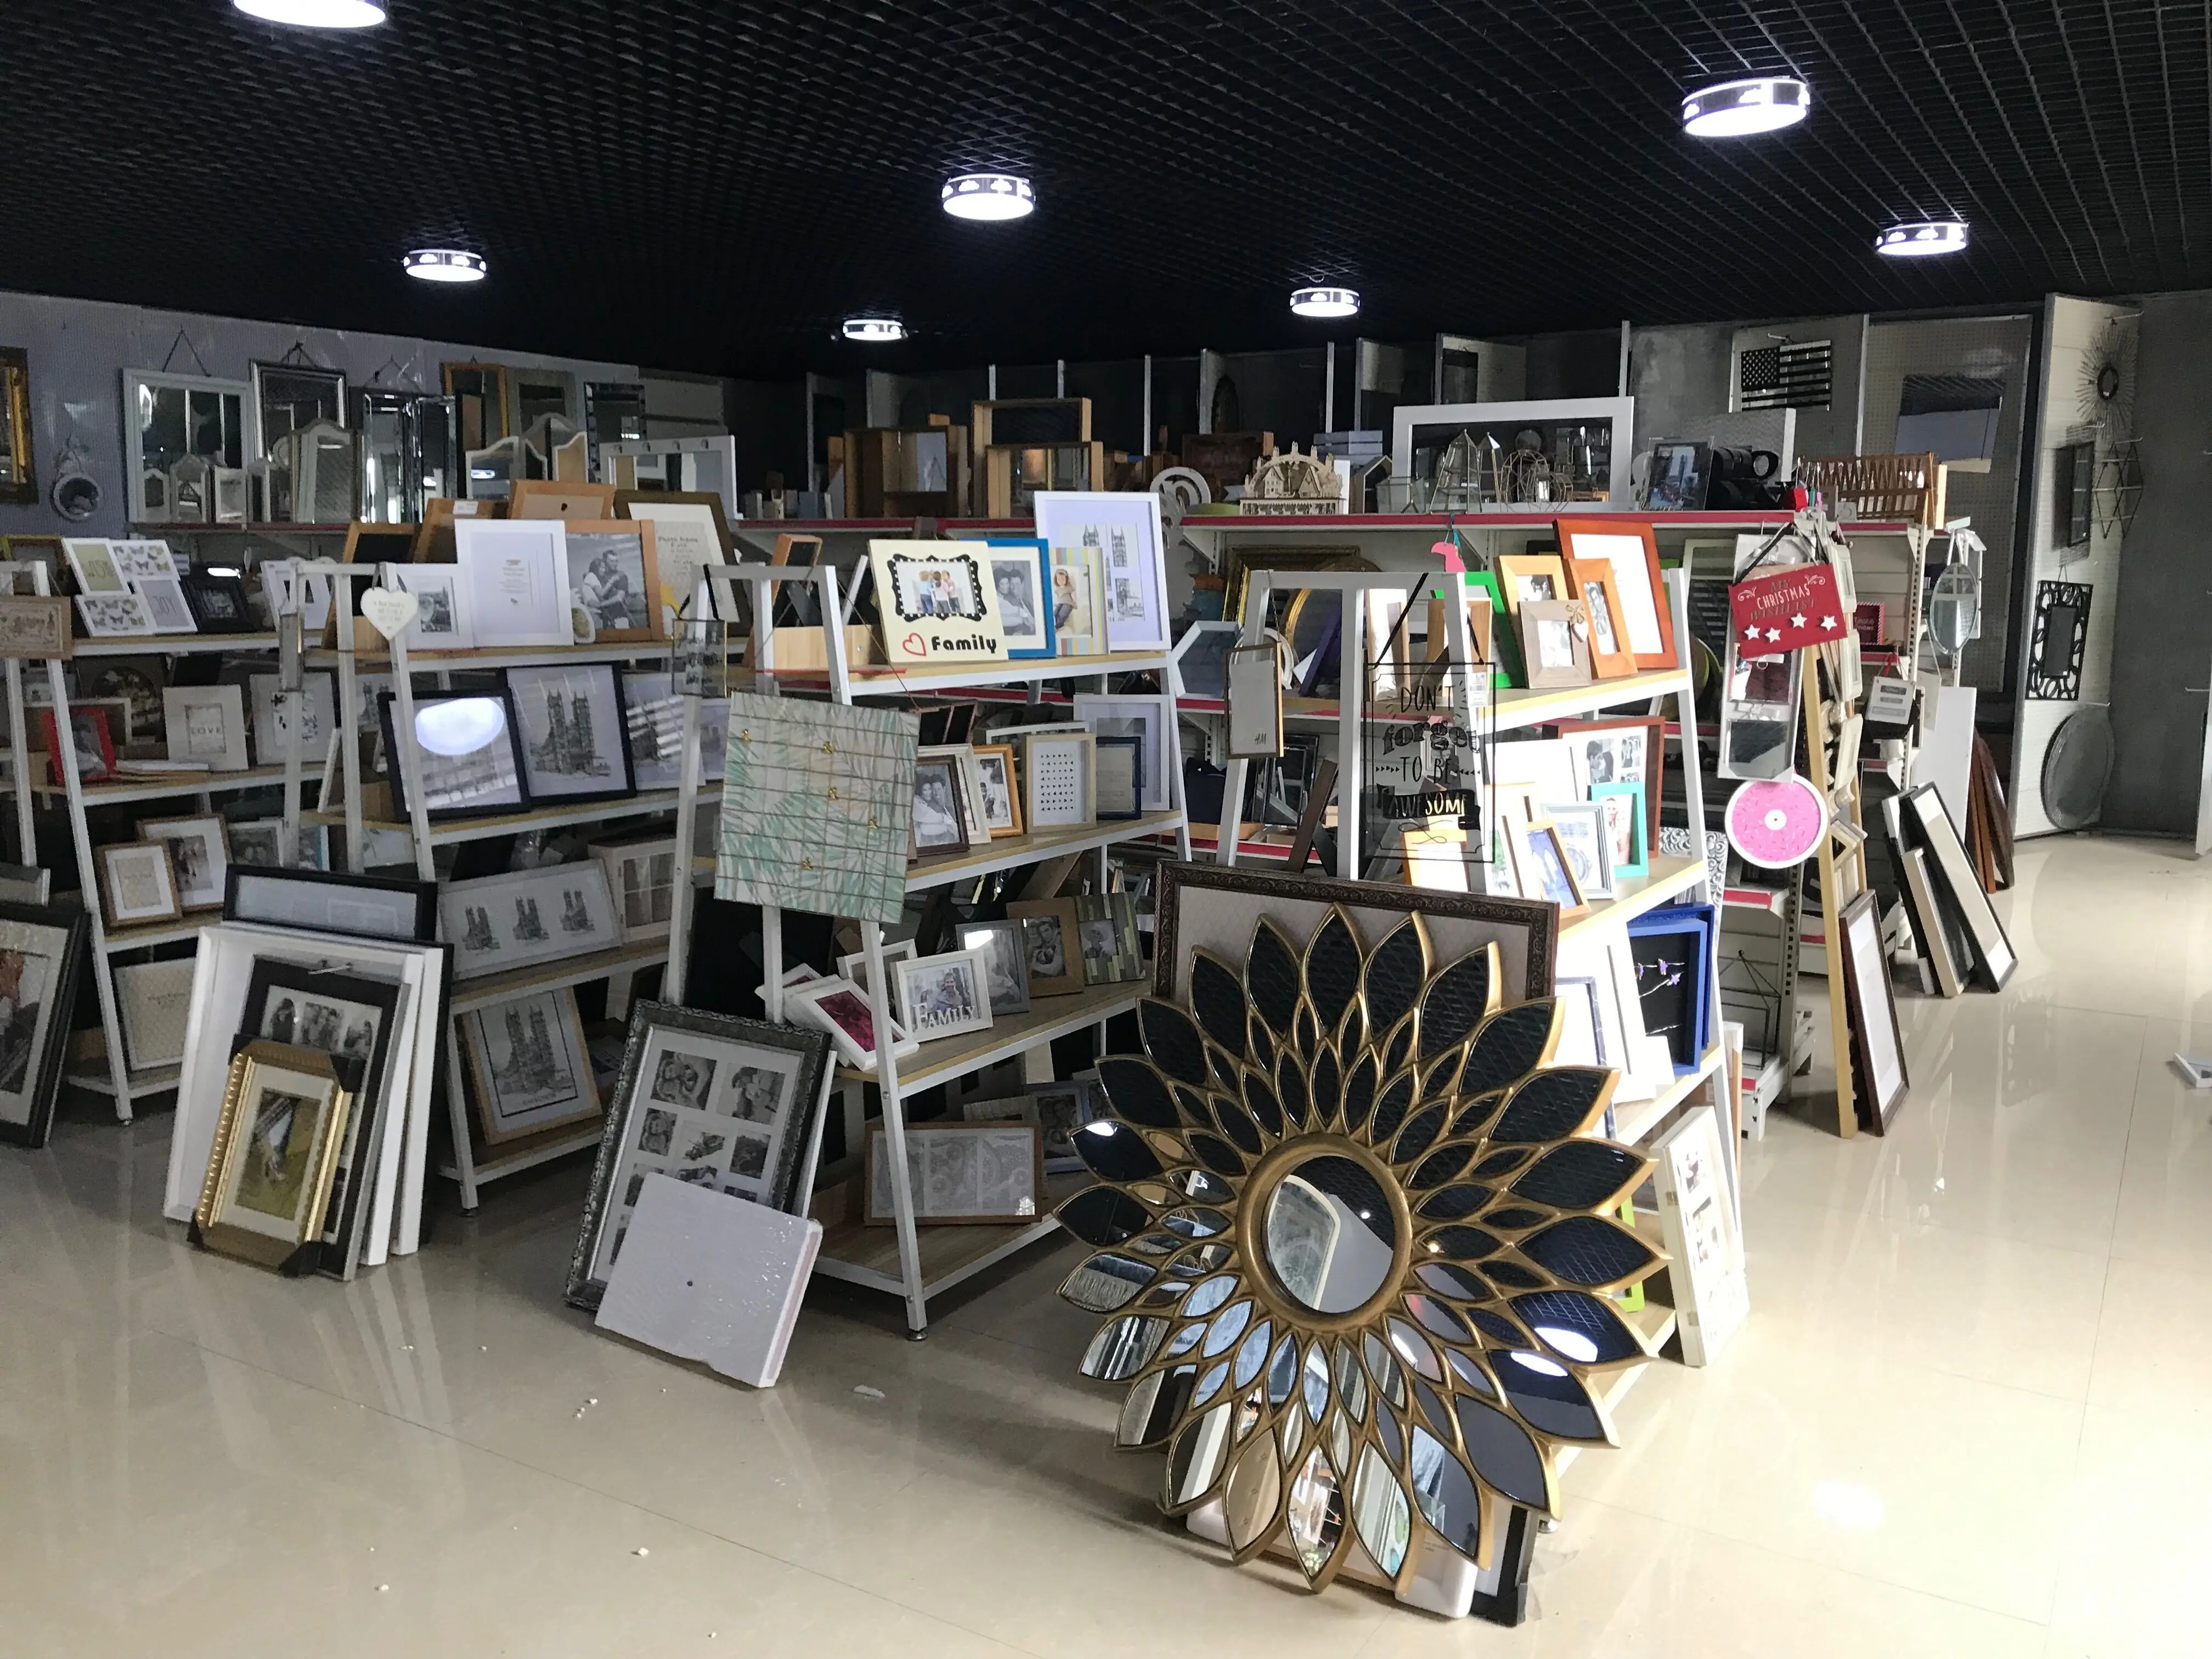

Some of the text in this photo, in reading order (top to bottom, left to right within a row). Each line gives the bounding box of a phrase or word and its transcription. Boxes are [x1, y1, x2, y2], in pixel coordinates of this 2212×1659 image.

[1757, 583, 1810, 610] CHRISTMAS
[931, 634, 996, 653] Family
[1401, 685, 1455, 713] DON'T
[1400, 757, 1422, 782] TO
